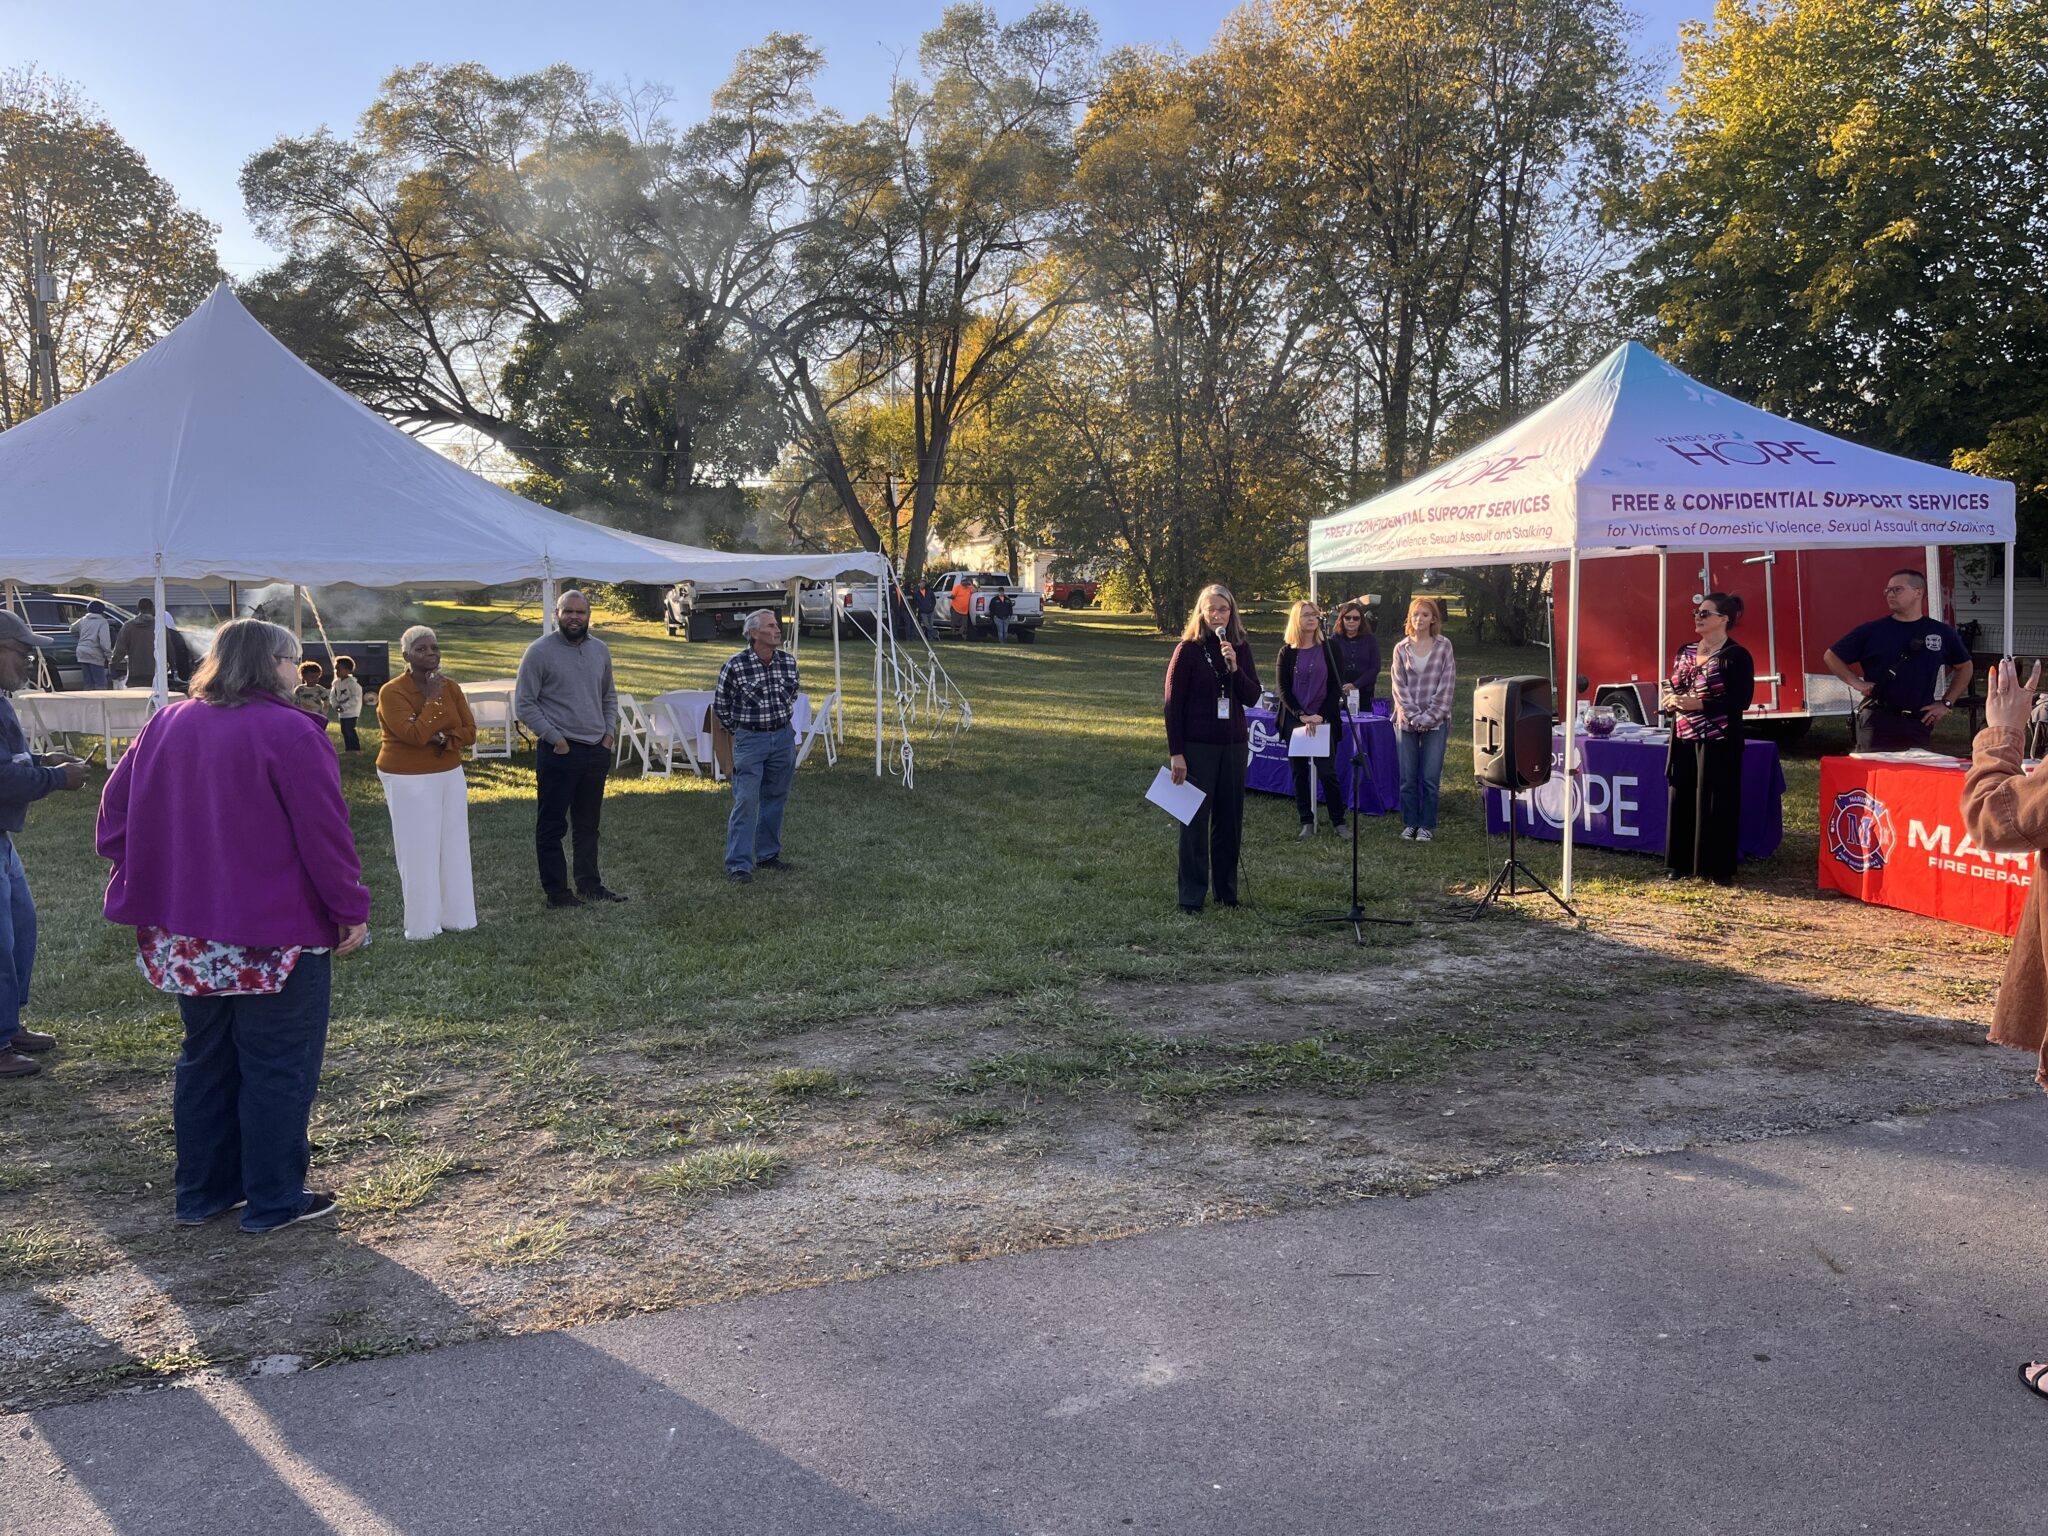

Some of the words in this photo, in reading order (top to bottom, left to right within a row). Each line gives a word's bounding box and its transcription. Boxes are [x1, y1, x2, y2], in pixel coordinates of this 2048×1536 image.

[1654, 433, 1706, 443] HANDS
[1708, 433, 1729, 441] OF
[1665, 441, 1837, 466] HOPE
[1414, 454, 1544, 496] HOPE
[1611, 493, 1660, 512] FREE
[1664, 494, 1676, 511] &
[1682, 491, 1818, 511] CONFIDENTIAL
[1823, 491, 1903, 509] SUPPORT
[1907, 493, 1990, 510] SERVICES
[1354, 508, 1425, 536] CONFIDENTIAL
[1428, 504, 1486, 523] SUPPORT
[1486, 494, 1550, 518] SERVICES
[1430, 531, 1458, 545] Sexual
[1460, 530, 1493, 543] Assault
[1494, 527, 1511, 540] and
[1513, 525, 1553, 539] Stalking
[1607, 524, 1626, 537] for
[1629, 523, 1680, 536] Victims
[1682, 522, 1696, 536] of
[1700, 520, 1763, 536] Domestic
[1765, 520, 1824, 534] Violence,
[1827, 519, 1871, 533] Sexual
[1874, 519, 1919, 533] Assault
[1921, 521, 1946, 532] and
[1947, 520, 1996, 536] Stalking
[1928, 856, 1967, 874] FIRE
